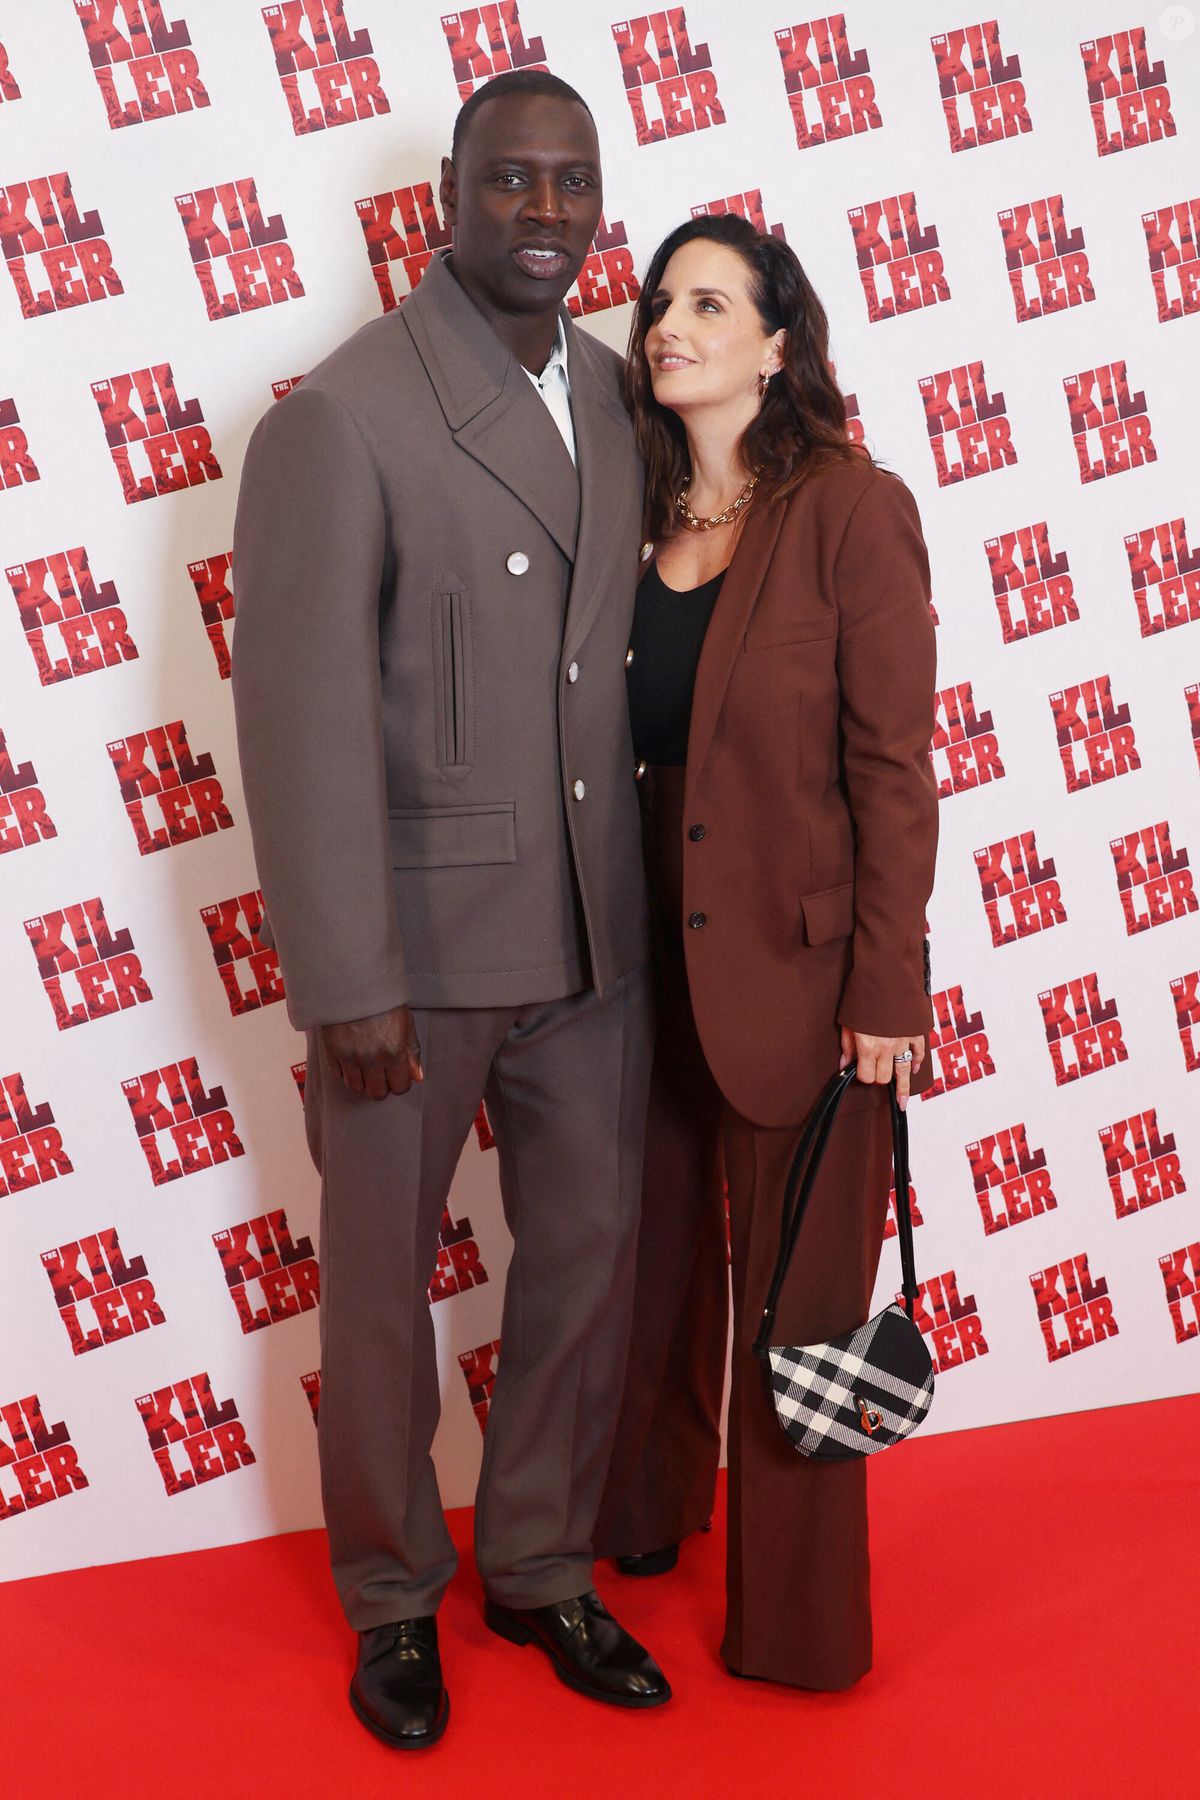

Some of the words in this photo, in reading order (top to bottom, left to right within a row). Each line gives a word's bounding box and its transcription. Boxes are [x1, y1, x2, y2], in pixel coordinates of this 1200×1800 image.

[73, 0, 192, 69] KIL
[261, 0, 374, 77] KIL
[440, 0, 546, 82] KIL
[611, 7, 712, 90] KIL
[774, 13, 871, 95] KIL
[930, 20, 1022, 100] KIL
[1080, 26, 1167, 105] KIL
[94, 49, 211, 130] LER
[280, 57, 391, 136] LER
[626, 70, 726, 147] LER
[788, 75, 883, 150] LER
[942, 80, 1033, 154] LER
[1090, 86, 1177, 158] LER
[0, 172, 105, 260] KIL
[174, 177, 288, 264] KIL
[847, 191, 940, 271] KIL
[997, 194, 1085, 272] KIL
[7, 238, 125, 320] LER
[194, 242, 306, 322] LER
[860, 250, 951, 323] LER
[1008, 252, 1096, 323] LER
[90, 363, 205, 449] KIL
[918, 360, 1007, 438] KIL
[1062, 360, 1148, 436] KIL
[110, 426, 224, 505] LER
[930, 416, 1018, 488] LER
[1073, 415, 1158, 485] LER
[5, 546, 121, 632] KIL
[984, 521, 1070, 597] KIL
[1123, 517, 1200, 591] KIL
[25, 607, 140, 687] LER
[995, 574, 1080, 645] LER
[1048, 674, 1132, 748] KIL
[106, 720, 216, 805] KIL
[1059, 725, 1142, 794] LER
[126, 778, 234, 857] LER
[973, 830, 1057, 904] KIL
[1109, 820, 1190, 893] KIL
[23, 897, 135, 981] KIL
[984, 879, 1068, 949] LER
[1119, 869, 1200, 937] LER
[43, 953, 154, 1032] LER
[1037, 972, 1119, 1044] KIL
[1048, 1019, 1129, 1088] LER
[121, 1056, 228, 1138] KIL
[140, 1110, 246, 1187] LER
[964, 1122, 1047, 1195] KIL
[1098, 1107, 1177, 1179] KIL
[976, 1169, 1058, 1237] LER
[1108, 1153, 1187, 1220] LER
[39, 1227, 149, 1309] KIL
[211, 1207, 315, 1288] KIL
[59, 1279, 167, 1357] LER
[1028, 1252, 1109, 1323] KIL
[1040, 1296, 1120, 1364] LER
[134, 1372, 239, 1452] KIL
[153, 1421, 257, 1497] LER
